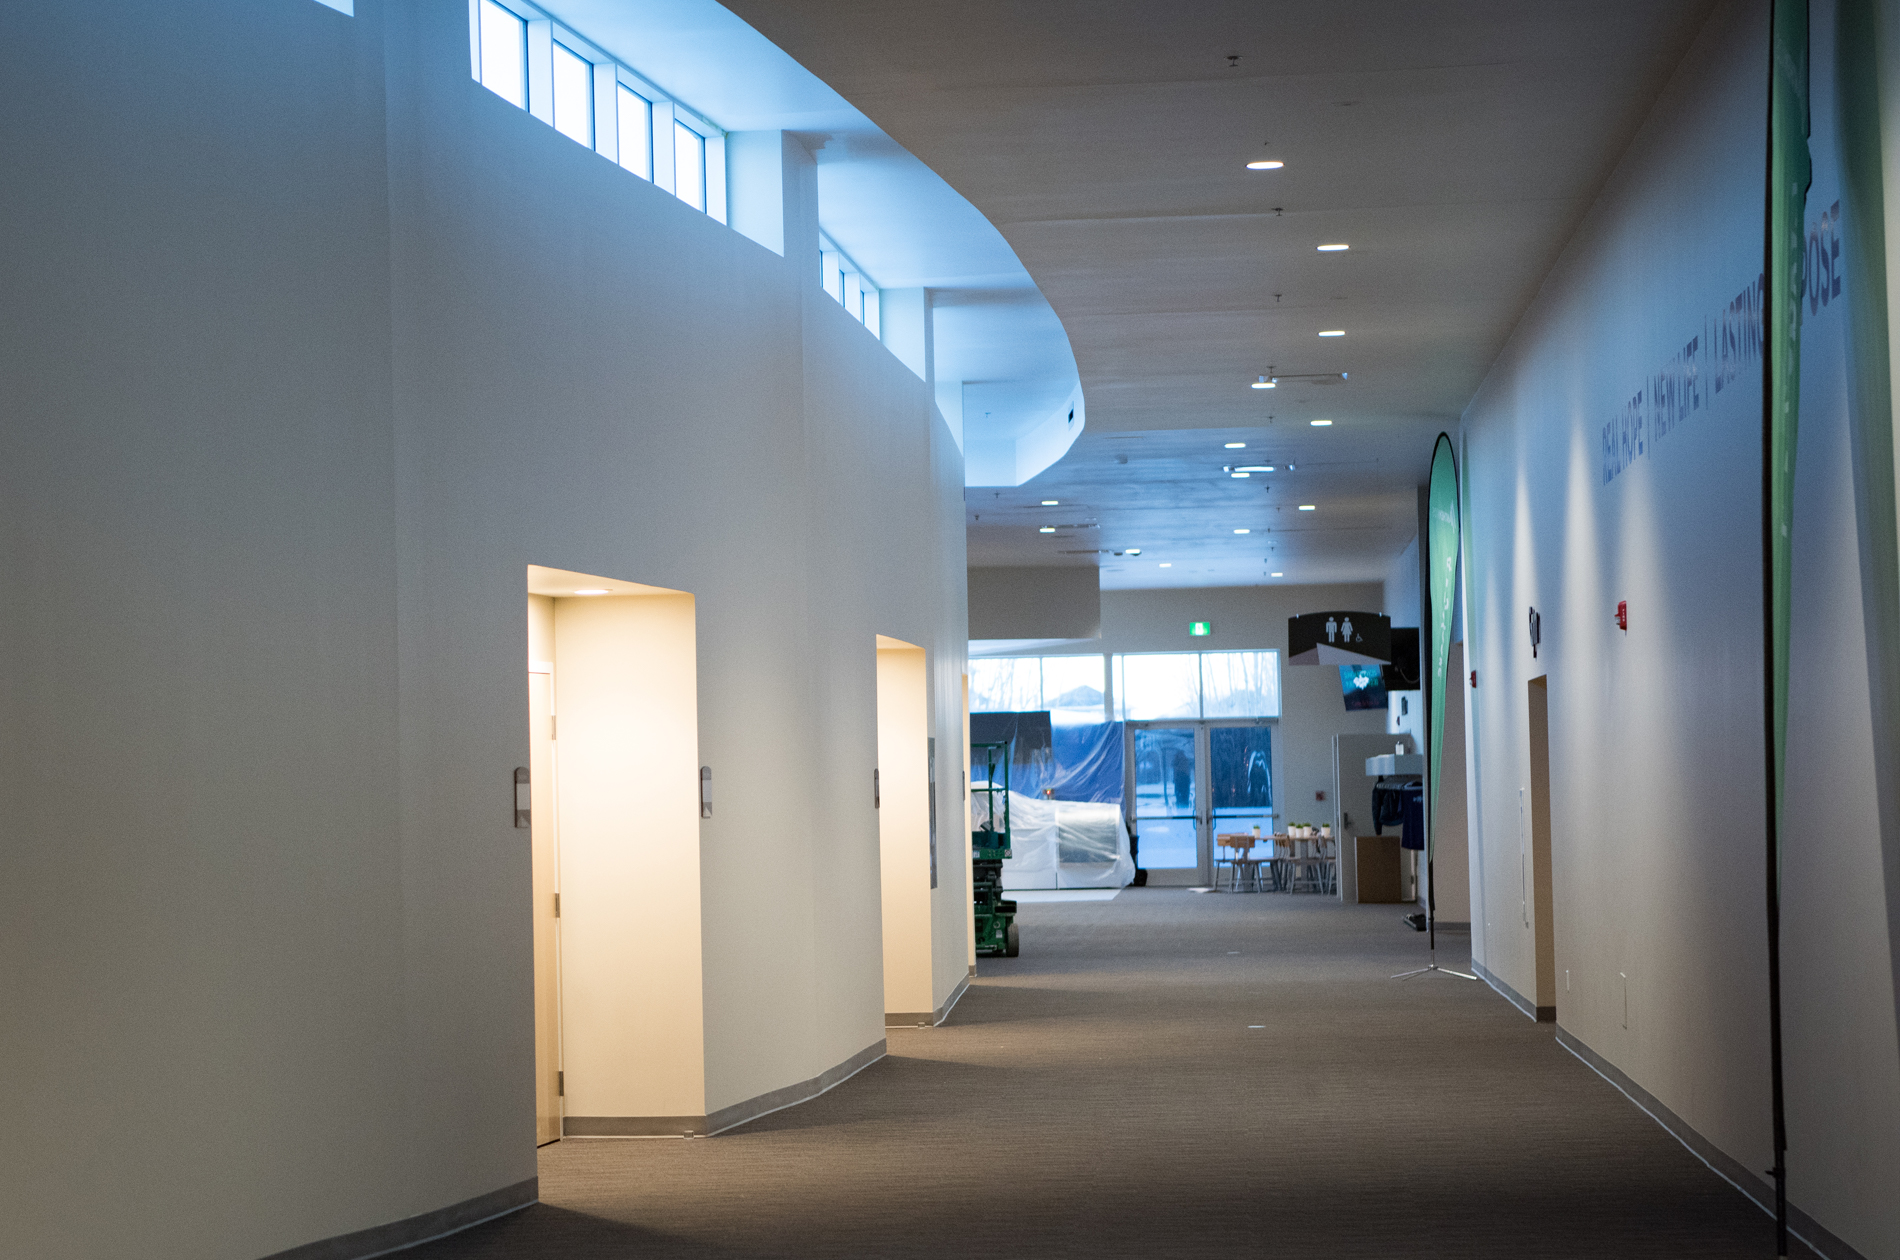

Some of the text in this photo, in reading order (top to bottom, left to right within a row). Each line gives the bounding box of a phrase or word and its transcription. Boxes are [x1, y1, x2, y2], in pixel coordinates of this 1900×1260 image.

[1602, 416, 1621, 486] REAL
[1622, 390, 1643, 471] HOPE
[1654, 357, 1675, 442] NEW
[1677, 336, 1699, 422] LIFE
